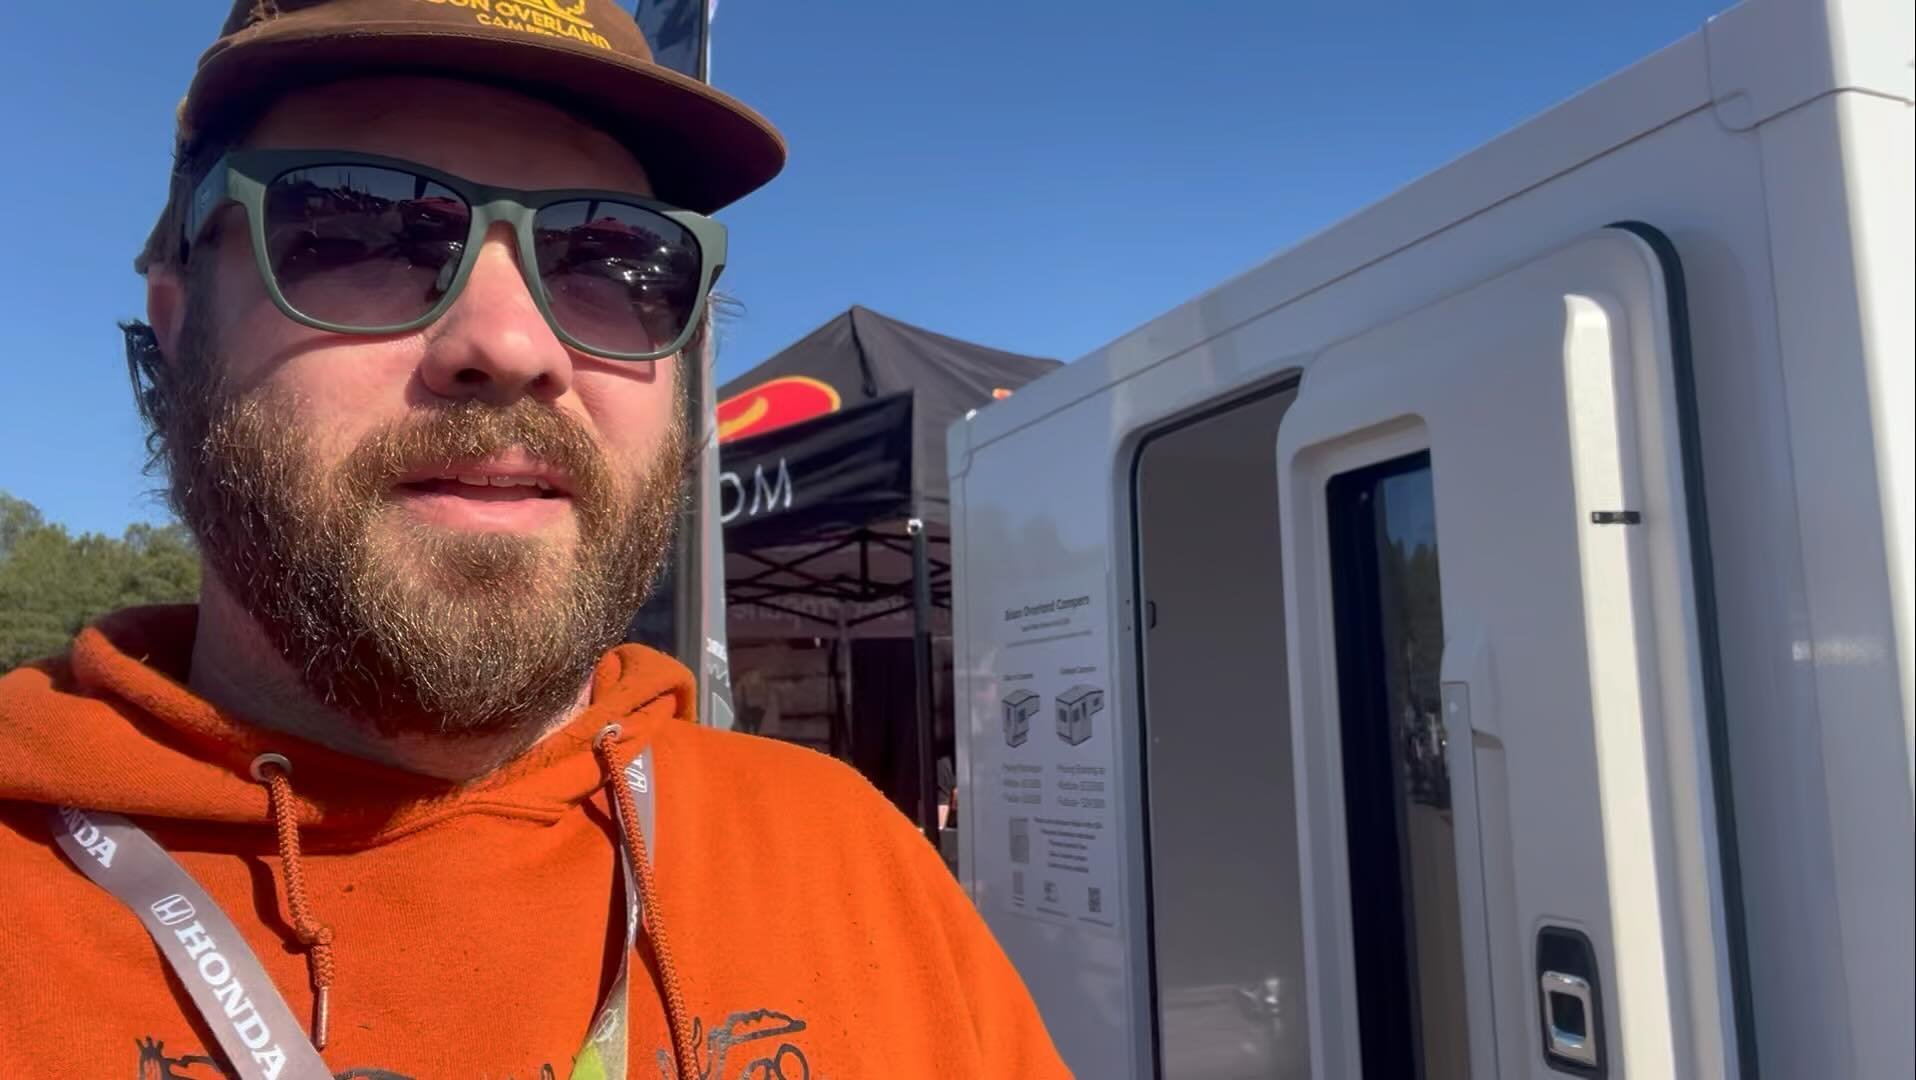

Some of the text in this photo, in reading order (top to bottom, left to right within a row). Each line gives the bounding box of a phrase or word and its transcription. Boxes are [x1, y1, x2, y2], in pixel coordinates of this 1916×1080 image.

[495, 2, 612, 50] OVERLAND
[58, 804, 118, 868] NDA
[174, 920, 288, 1080] HONDA
